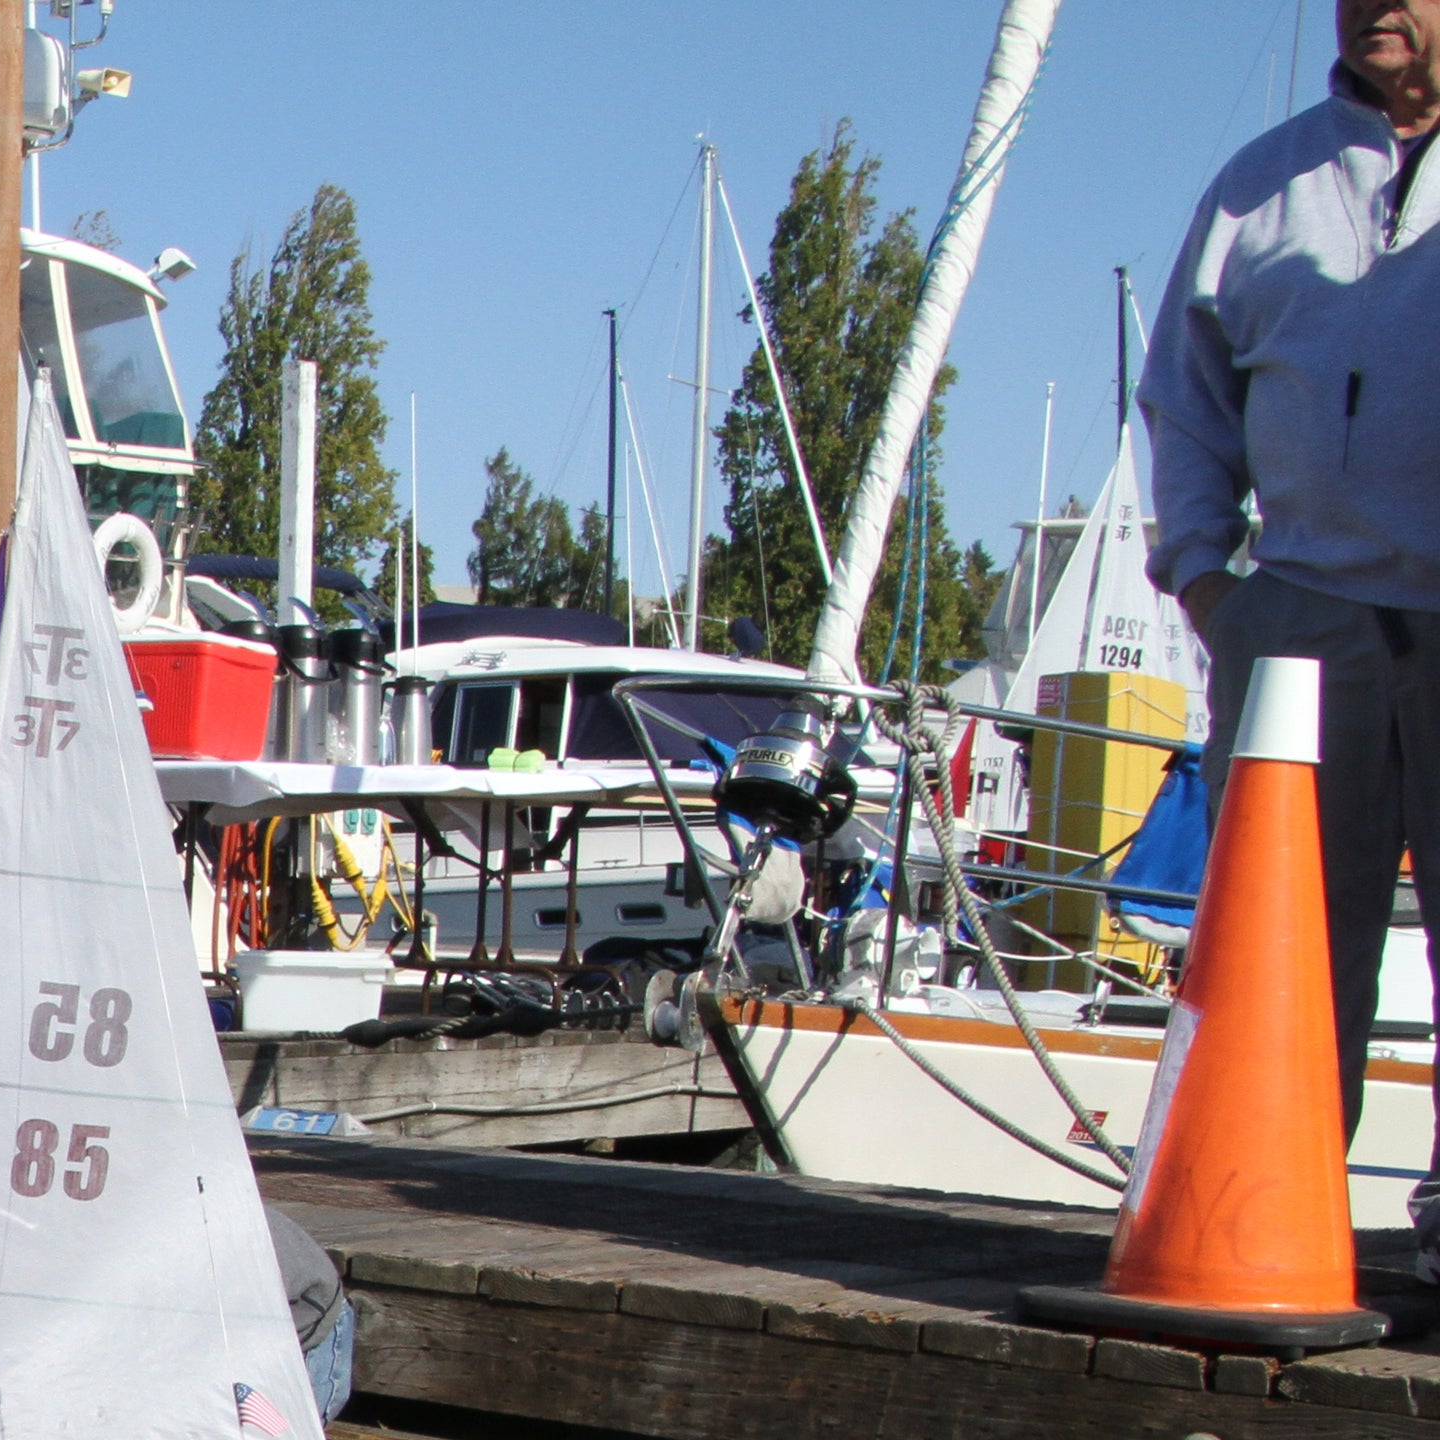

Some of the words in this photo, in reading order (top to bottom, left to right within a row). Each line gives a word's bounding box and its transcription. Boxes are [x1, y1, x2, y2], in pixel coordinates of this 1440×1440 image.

[1099, 643, 1143, 669] 1294
[748, 749, 796, 769] FURLEX
[273, 1112, 319, 1132] 61
[10, 1118, 112, 1202] 85
